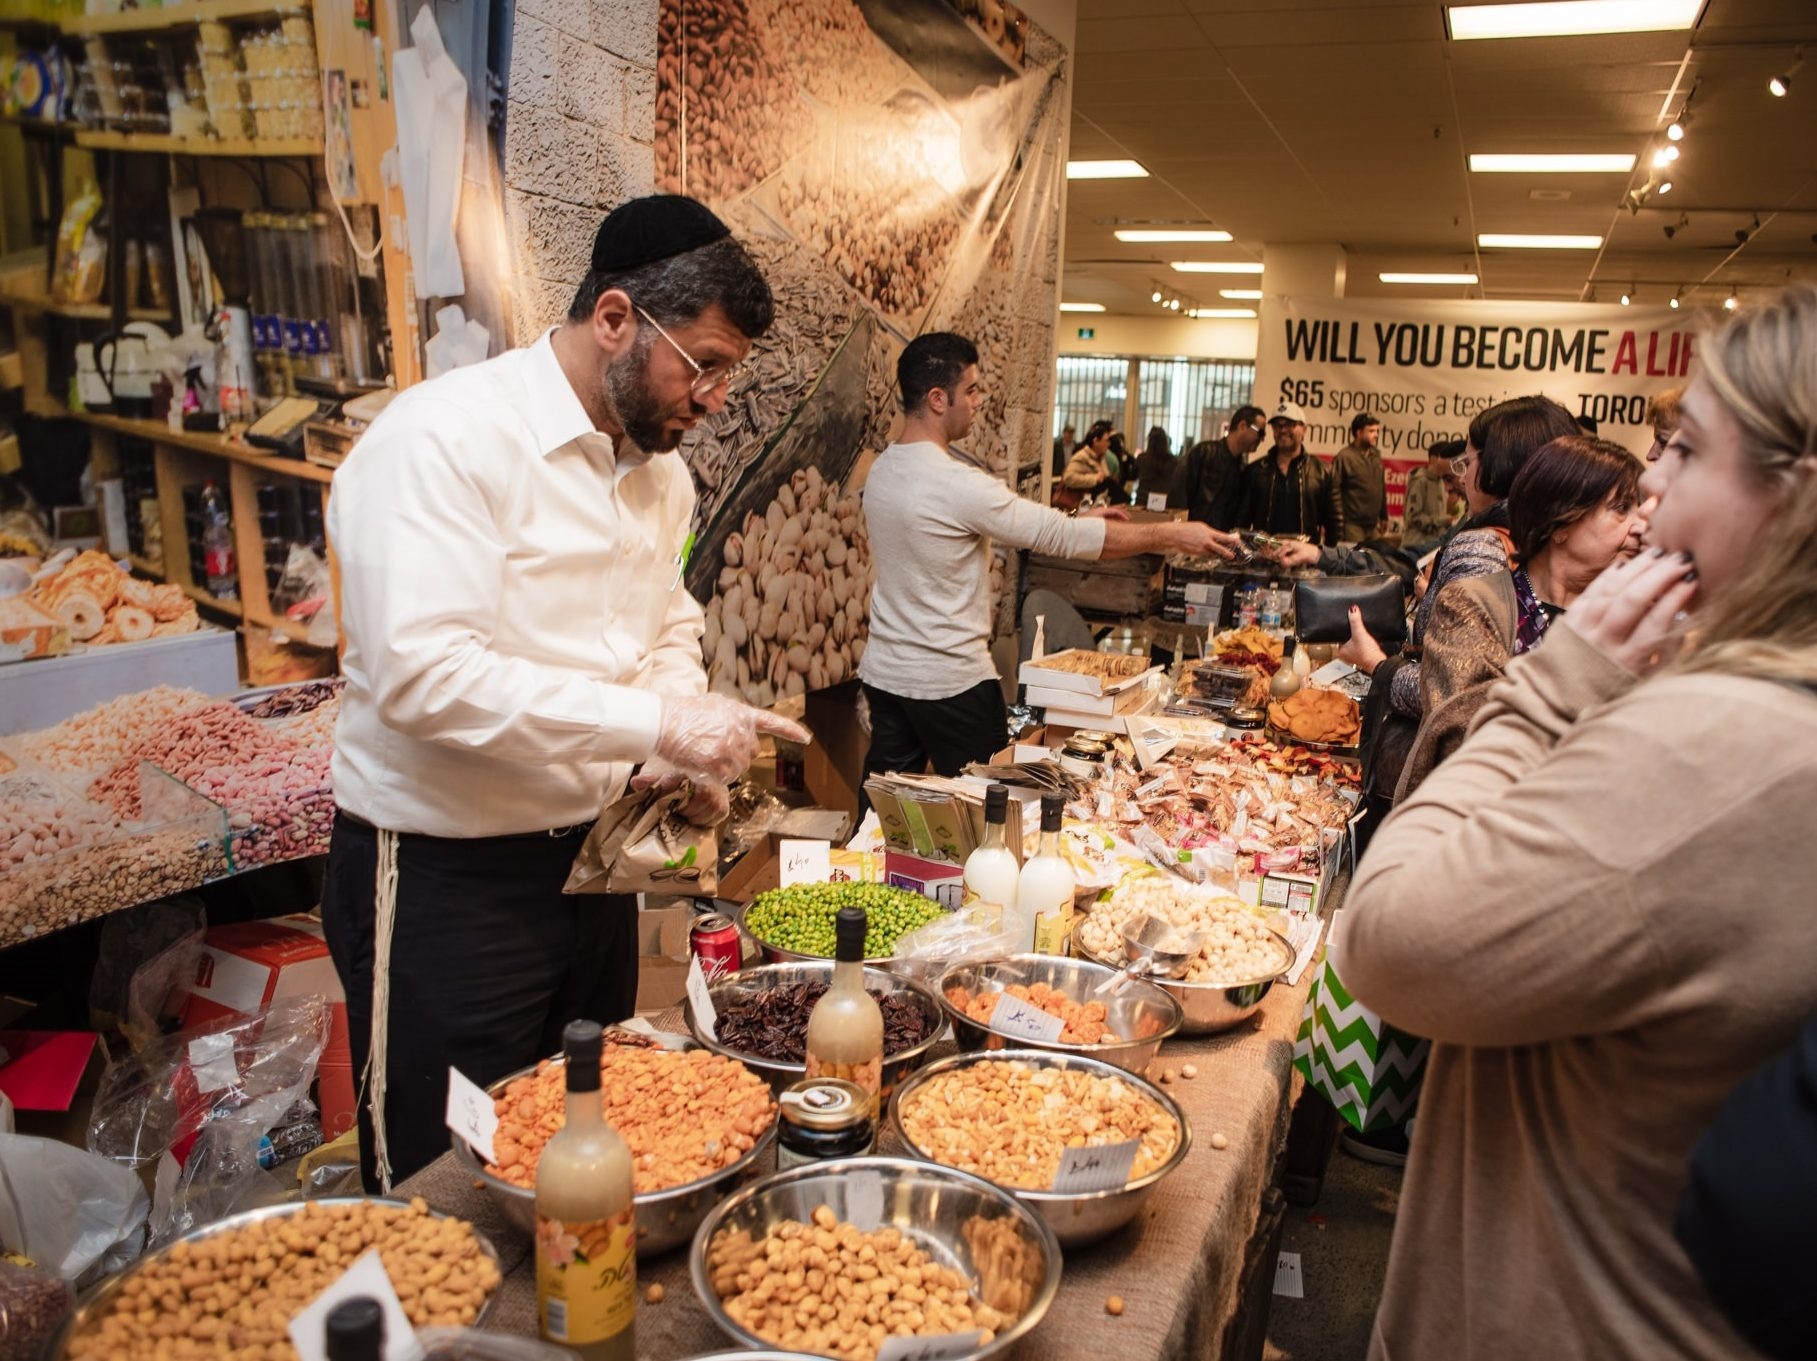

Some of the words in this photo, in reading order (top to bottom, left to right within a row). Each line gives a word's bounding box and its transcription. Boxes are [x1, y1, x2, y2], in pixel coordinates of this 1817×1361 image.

[1285, 318, 1366, 364] WILL
[1374, 322, 1444, 367] YOU
[1451, 325, 1609, 374] BECOME
[1611, 330, 1638, 375] A
[1645, 330, 1699, 377] LIF
[1279, 377, 1324, 408] $65
[1329, 390, 1425, 416] sponsors
[1434, 394, 1446, 416] a
[1578, 394, 1654, 425] TORO
